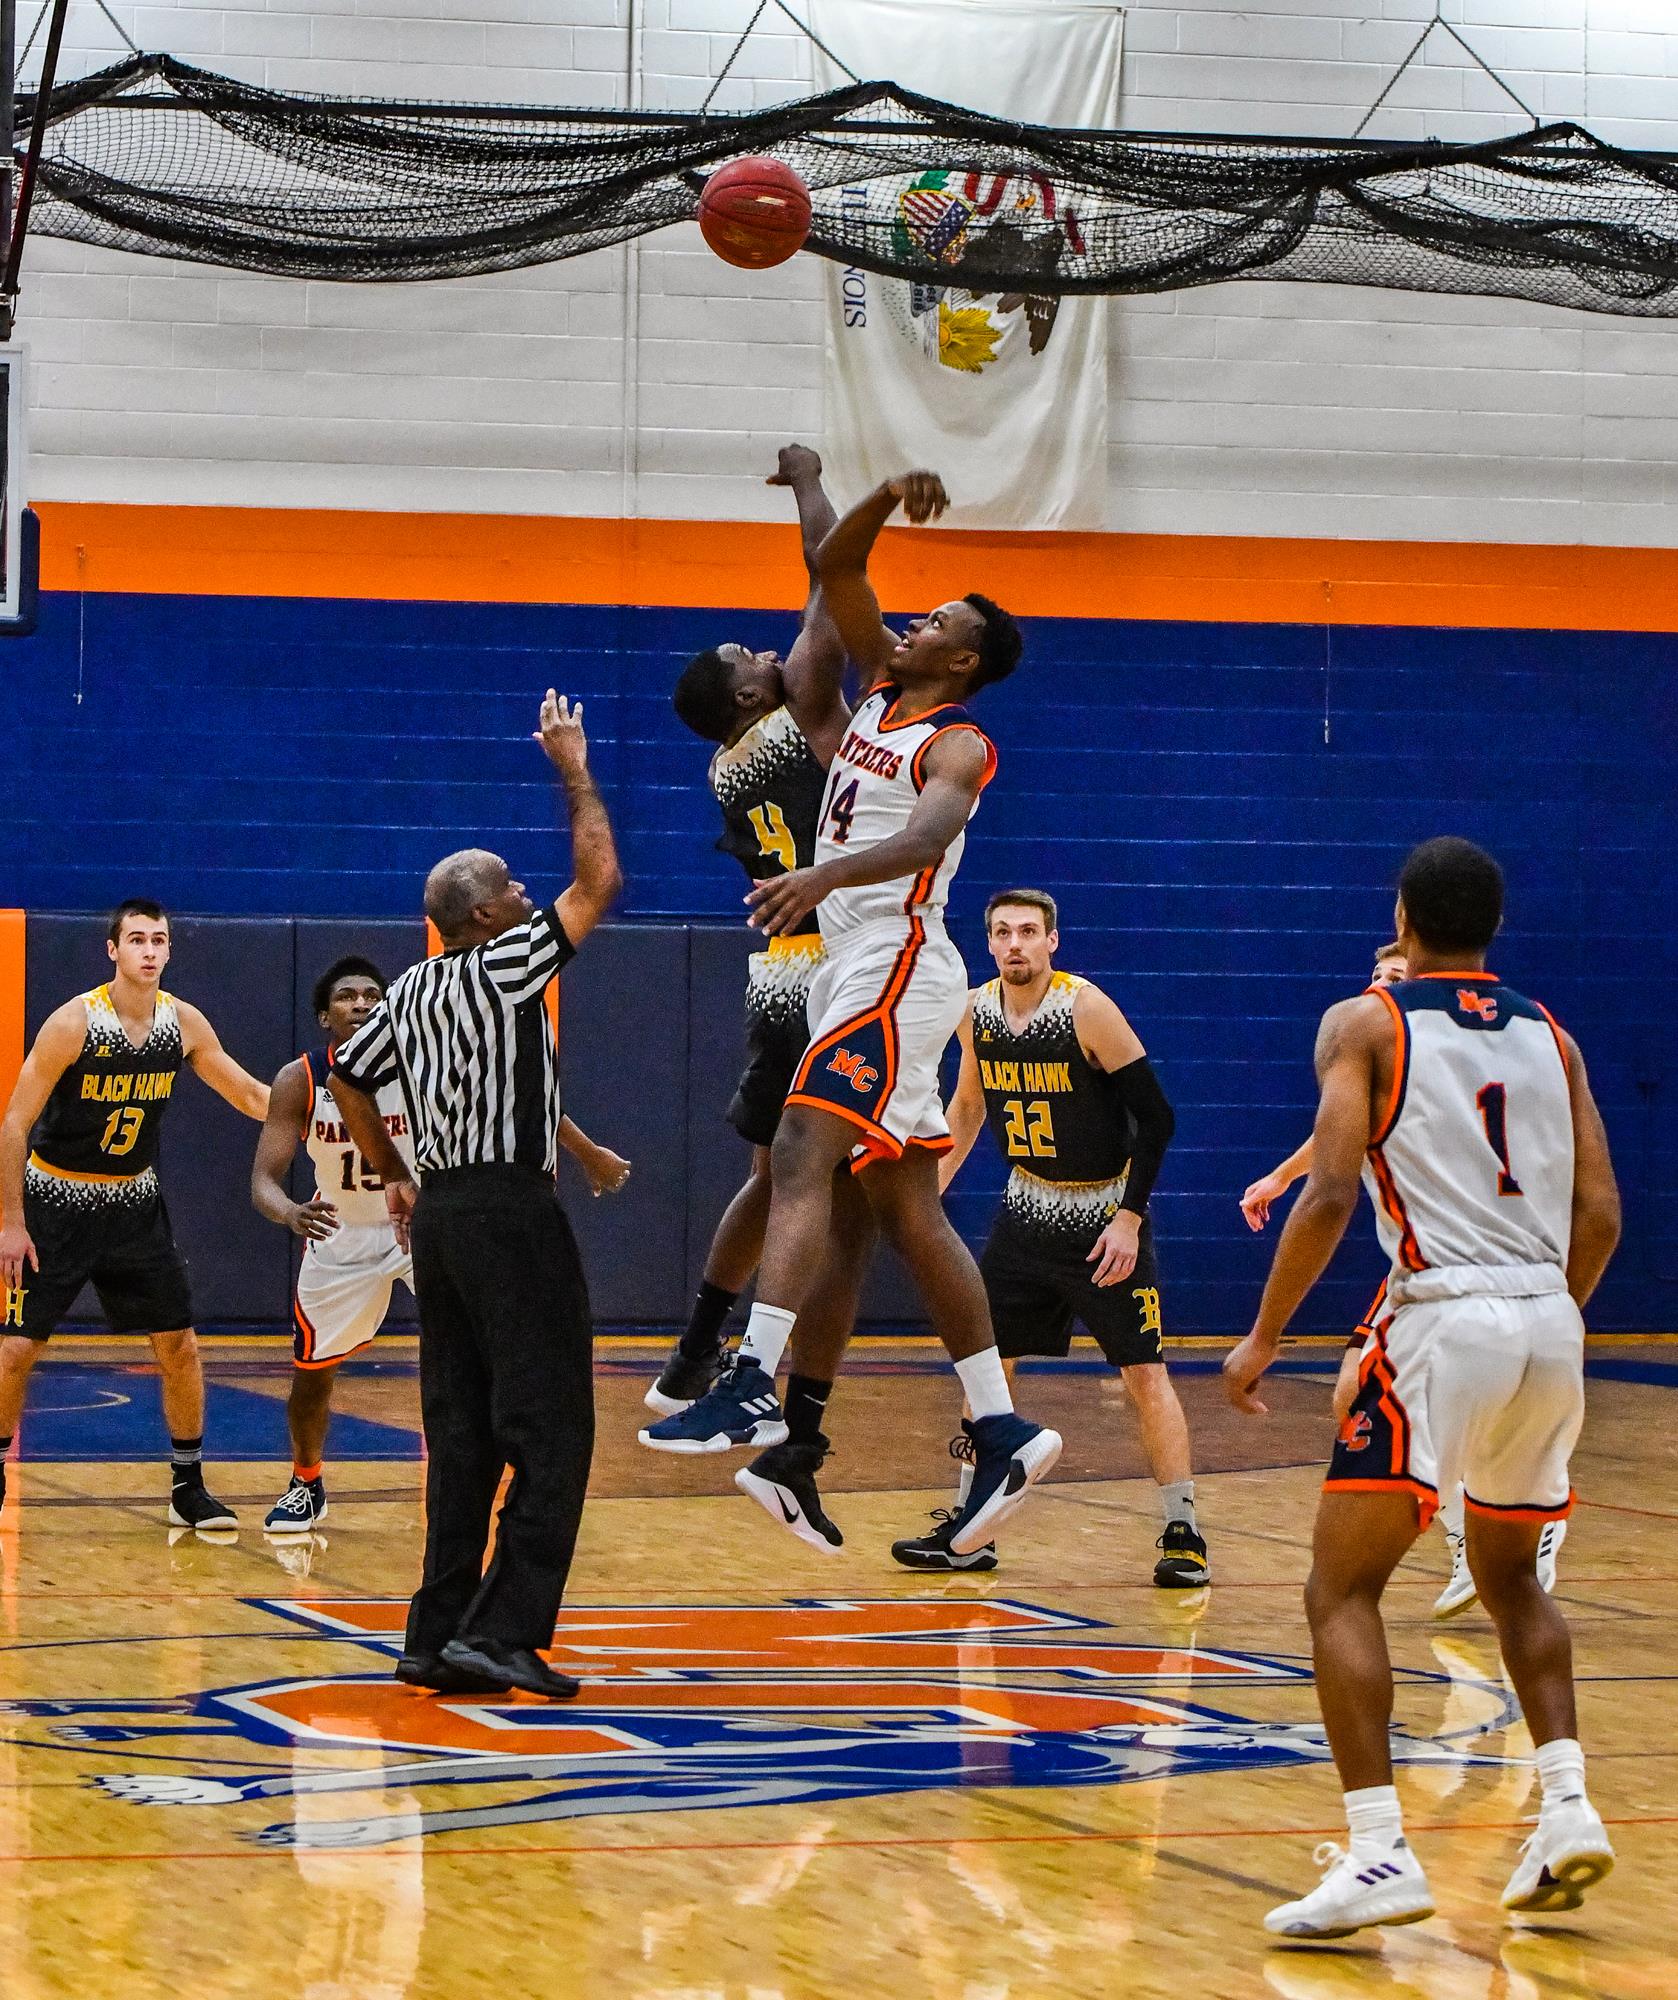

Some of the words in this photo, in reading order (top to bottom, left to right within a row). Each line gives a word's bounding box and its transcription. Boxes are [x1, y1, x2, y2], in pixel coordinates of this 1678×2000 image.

[819, 770, 860, 845] 14
[747, 800, 797, 872] 4
[81, 1074, 133, 1102] BLACK
[132, 1071, 176, 1101] HAWK
[826, 1048, 878, 1092] MC
[980, 1060, 1022, 1092] BLACK
[1023, 1062, 1073, 1092] HAWK
[100, 1107, 145, 1155] 13
[1003, 1100, 1057, 1157] 22
[1476, 1081, 1523, 1196] 1
[341, 1150, 385, 1192] 15
